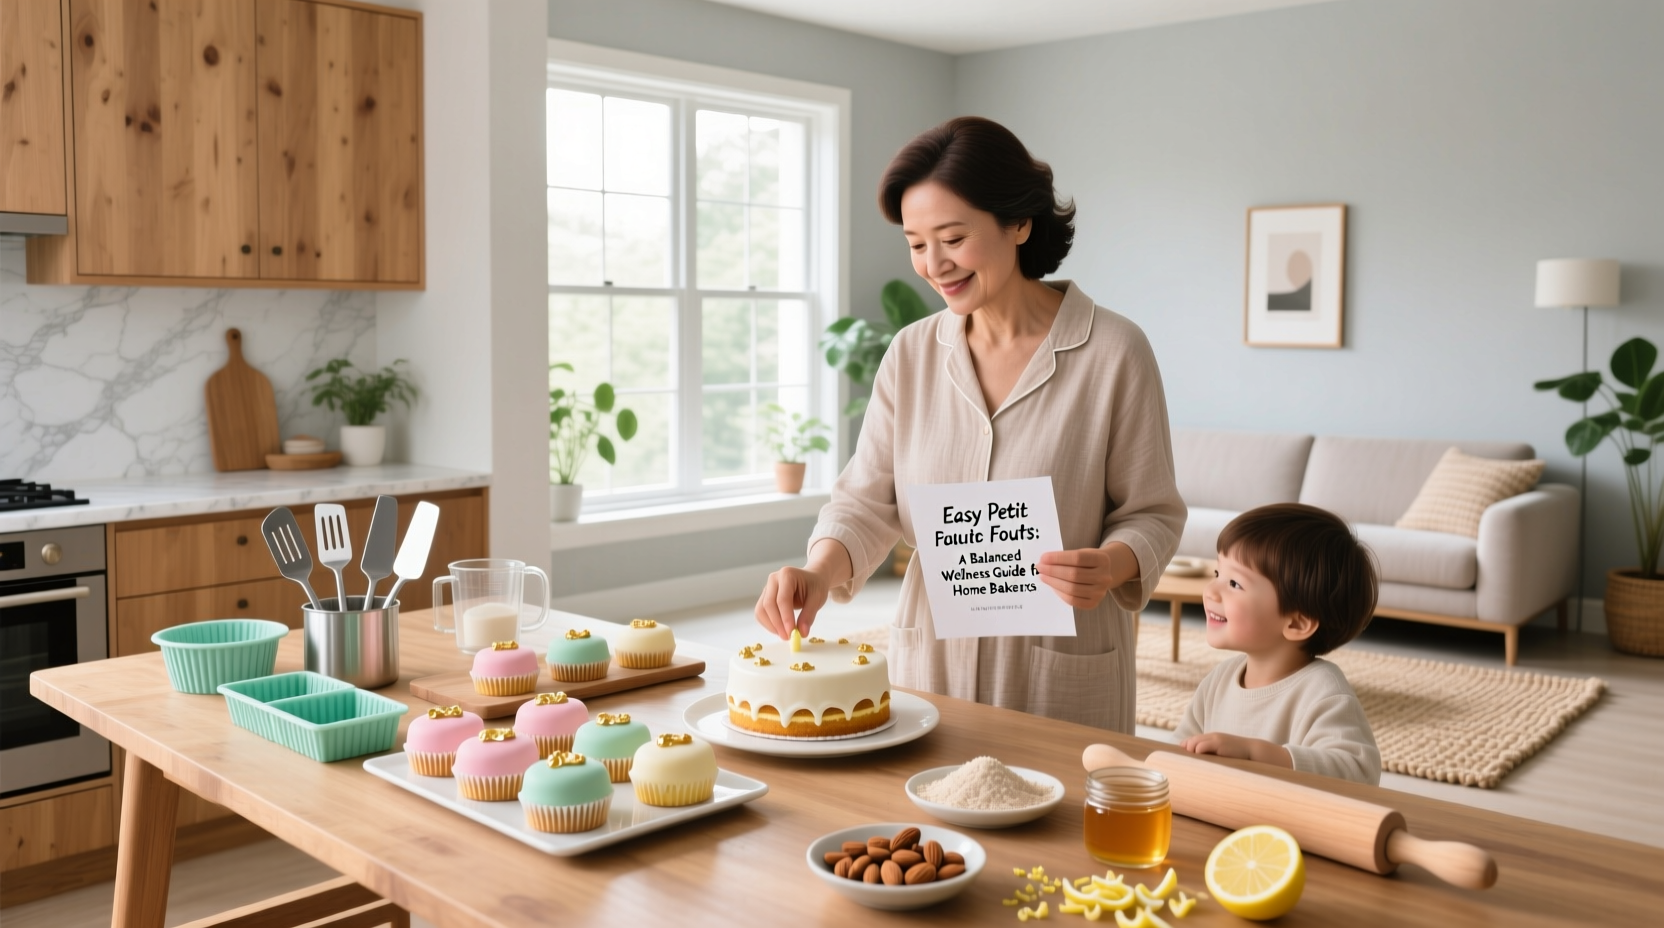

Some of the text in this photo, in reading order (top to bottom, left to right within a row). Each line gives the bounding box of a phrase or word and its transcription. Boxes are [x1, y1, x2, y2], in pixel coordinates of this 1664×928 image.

[944, 502, 1028, 526] Easy Petit
[959, 549, 1021, 565] A Balanced
[993, 564, 1026, 578] Guide
[953, 584, 986, 596] Home
